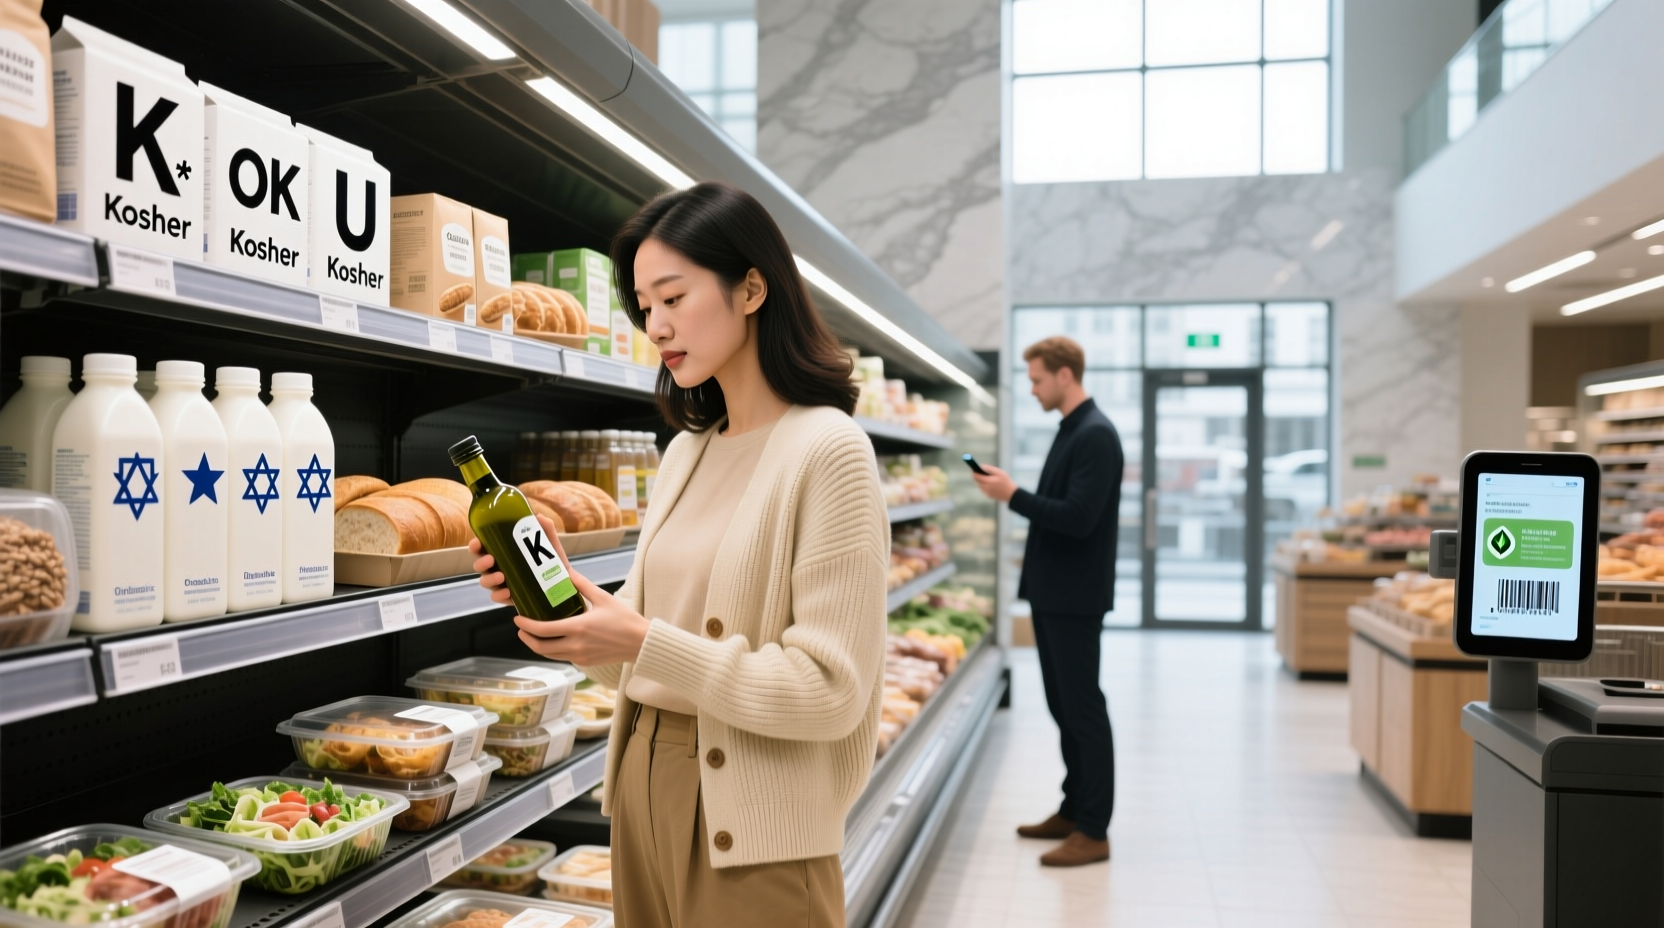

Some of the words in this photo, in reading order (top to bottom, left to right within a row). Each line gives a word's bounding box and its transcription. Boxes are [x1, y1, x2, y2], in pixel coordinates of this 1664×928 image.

[229, 148, 301, 222] OK
[104, 193, 192, 239] Kosher
[335, 169, 376, 252] U
[230, 228, 300, 268] Kosher
[327, 256, 384, 289] Kosher
[523, 530, 556, 567] K
